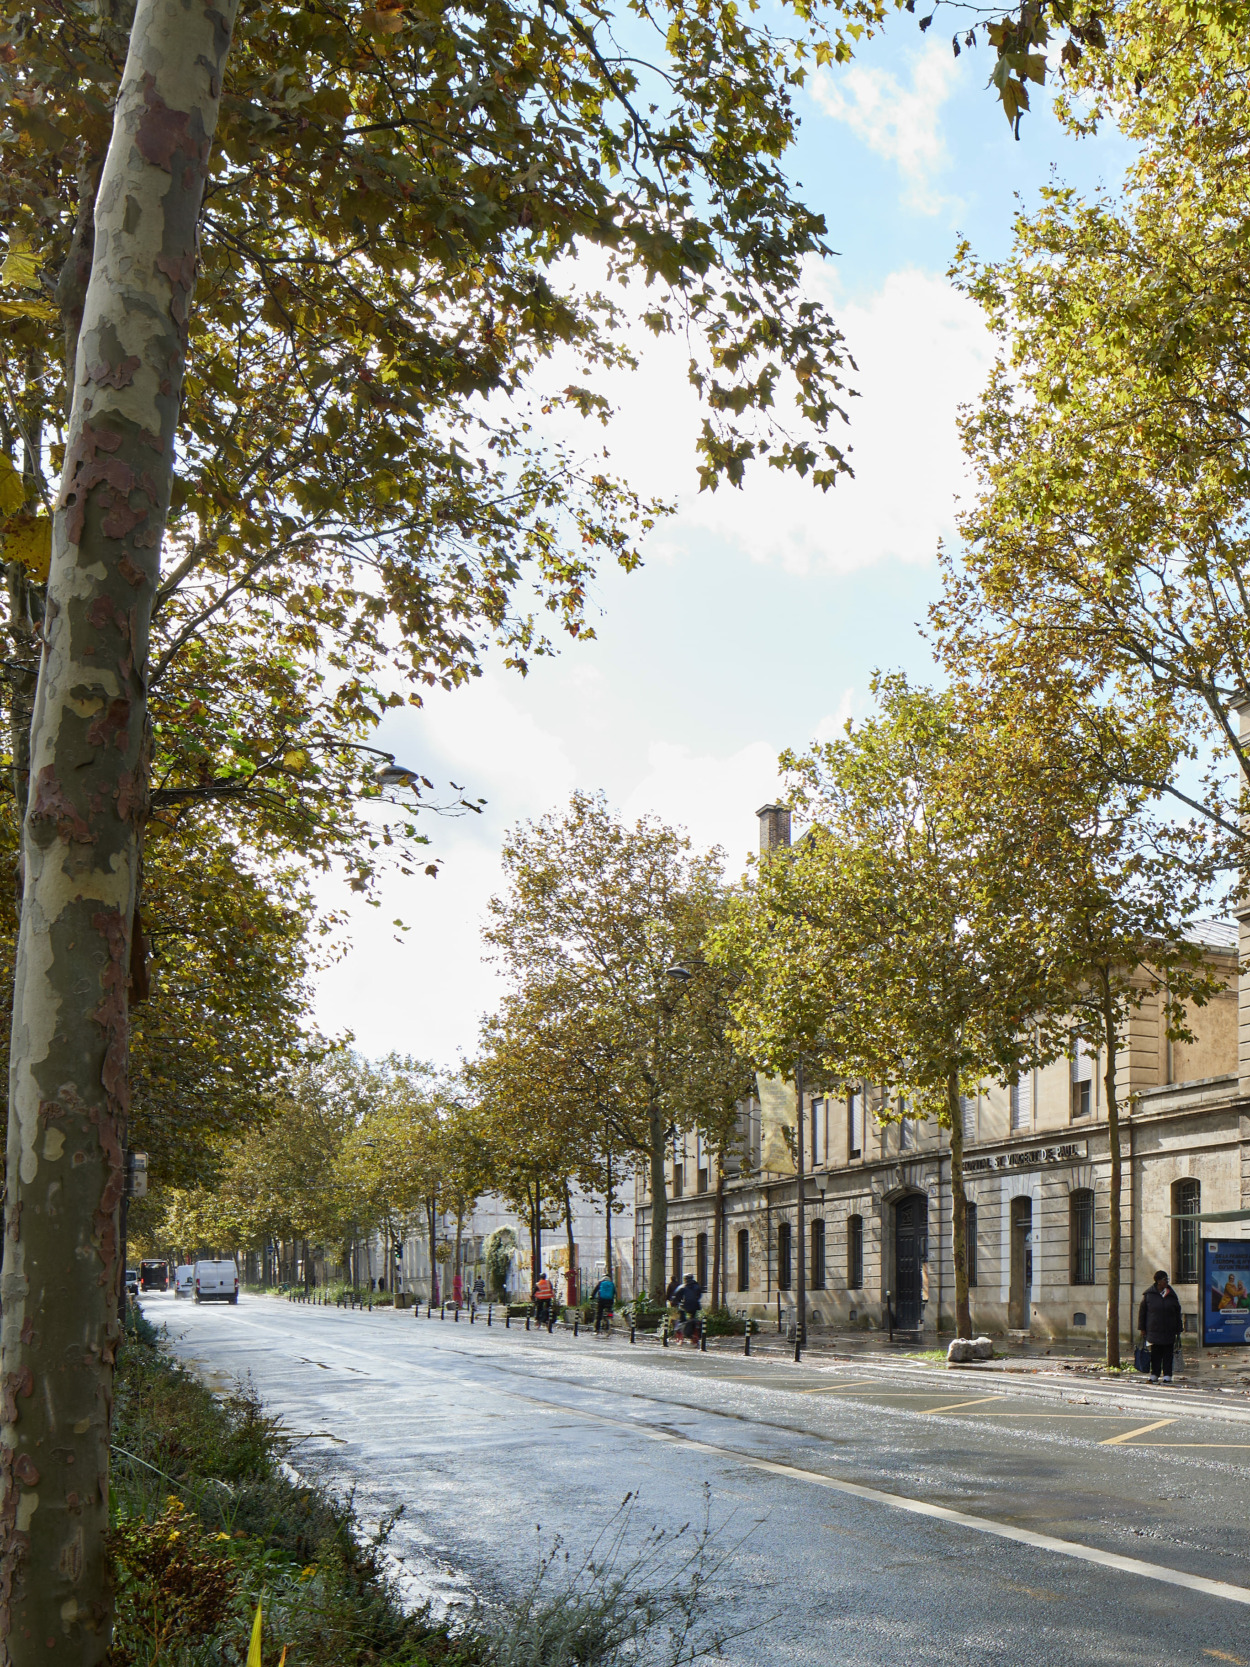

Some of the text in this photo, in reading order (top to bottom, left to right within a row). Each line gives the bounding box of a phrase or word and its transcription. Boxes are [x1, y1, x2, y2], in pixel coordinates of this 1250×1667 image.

[1006, 1150, 1041, 1166] VINCENT
[1041, 1148, 1055, 1161] DE
[1055, 1144, 1079, 1158] PAUL
